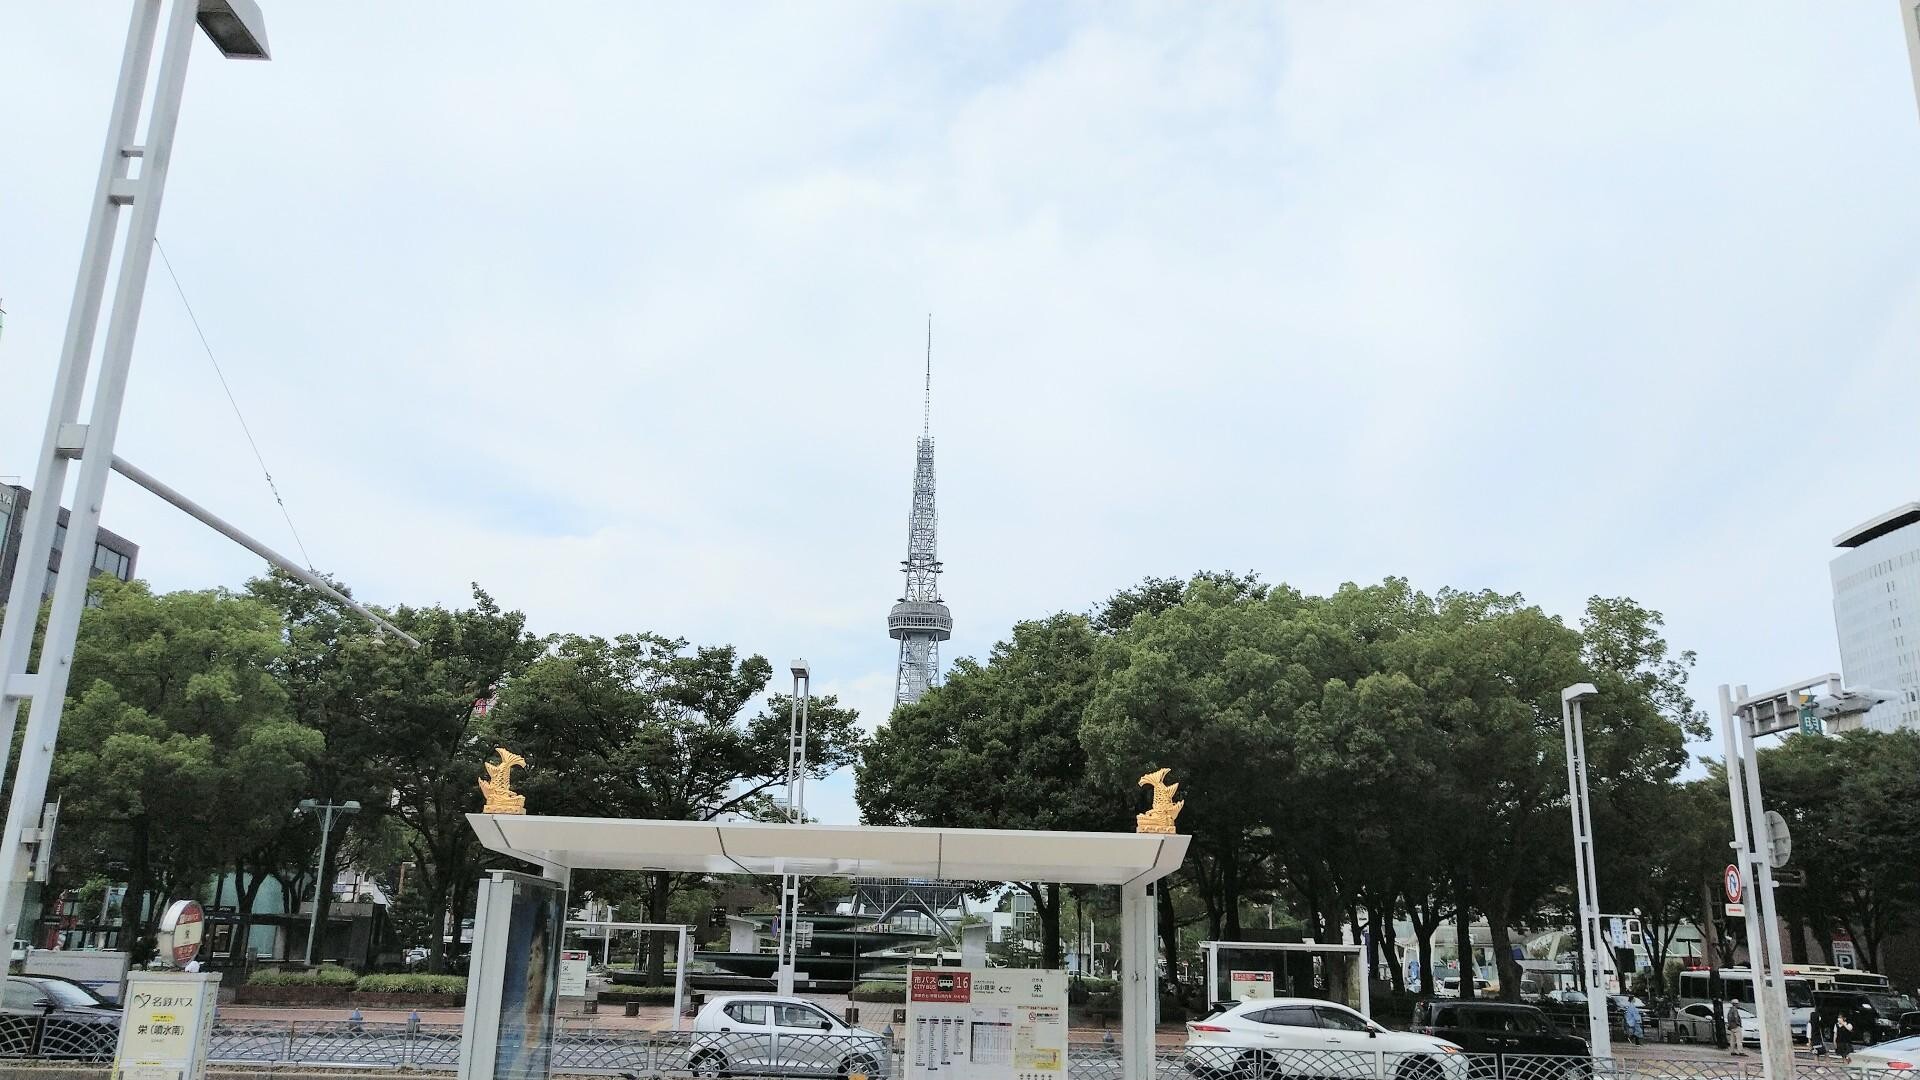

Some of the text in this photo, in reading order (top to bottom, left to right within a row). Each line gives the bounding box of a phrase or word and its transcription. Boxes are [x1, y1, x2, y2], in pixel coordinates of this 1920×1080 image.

[1839, 955, 1851, 968] P
[914, 976, 937, 984] 市バス
[956, 976, 969, 989] 16
[152, 996, 193, 1007] 名鉄バス
